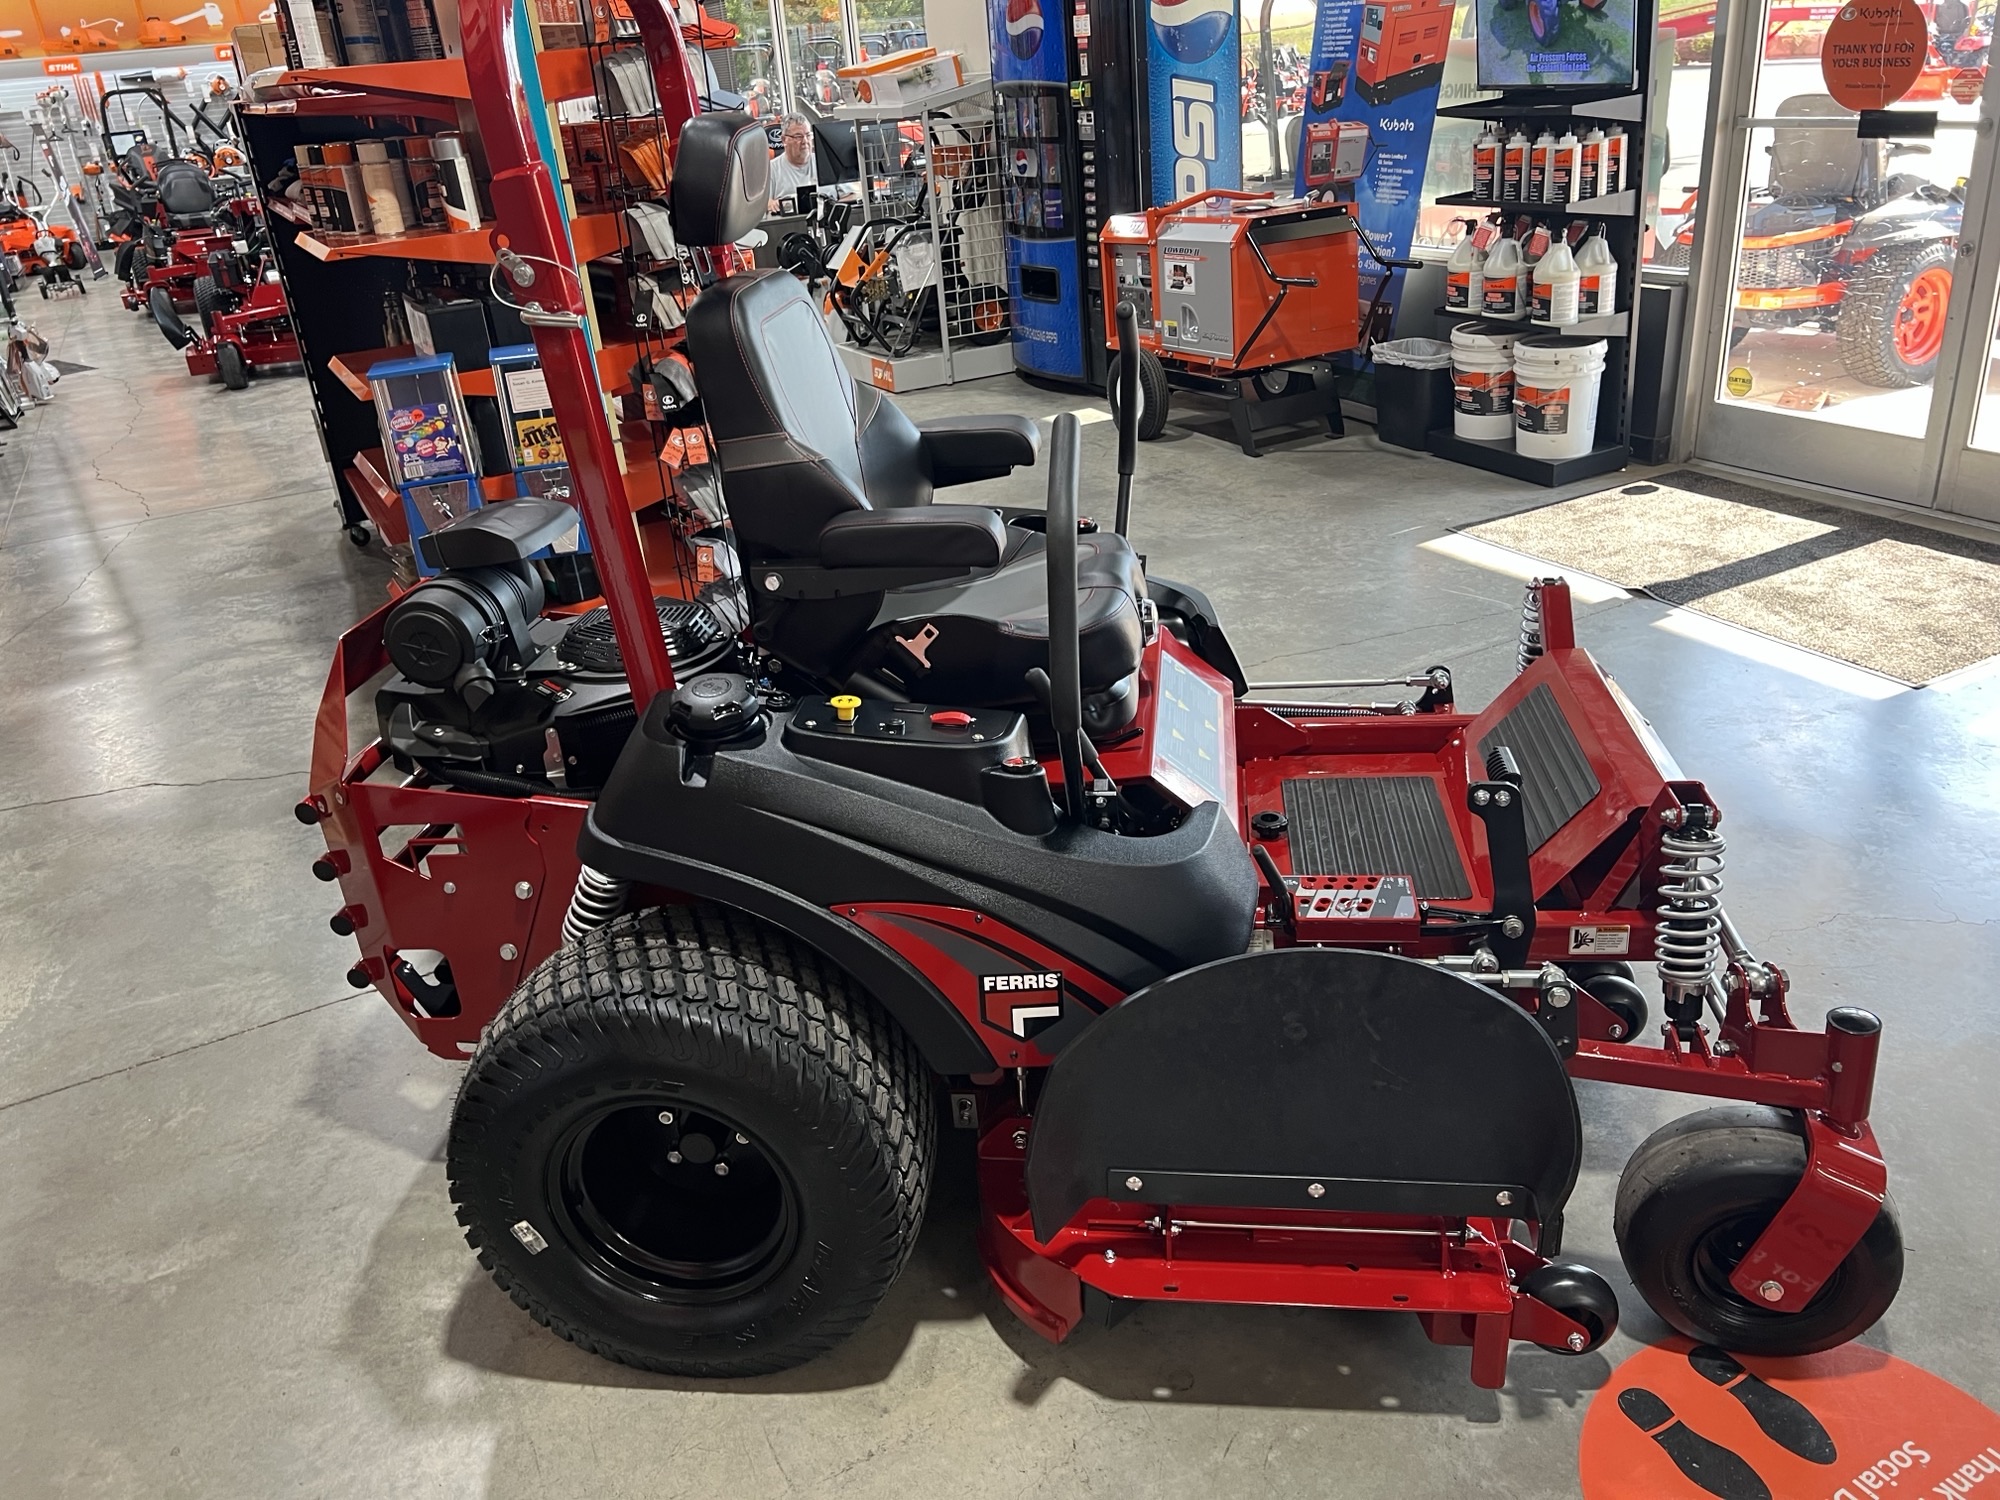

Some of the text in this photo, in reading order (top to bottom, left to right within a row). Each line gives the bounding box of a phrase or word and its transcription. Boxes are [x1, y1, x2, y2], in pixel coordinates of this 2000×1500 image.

[1860, 7, 1902, 19] Kubota
[1833, 42, 1915, 55] THANK YOU FOR
[1530, 52, 1587, 62] Air Pressure Forces
[1832, 57, 1911, 68] YOUR BUSINESS
[48, 63, 78, 72] STIHL
[1380, 118, 1414, 132] Kubota
[1364, 229, 1393, 243] Power?
[1164, 247, 1193, 256] LOWBOY
[1358, 274, 1377, 286] ngines
[873, 367, 893, 382] STHL
[984, 973, 1059, 991] FERRIS
[1852, 1441, 1931, 1500] Social
